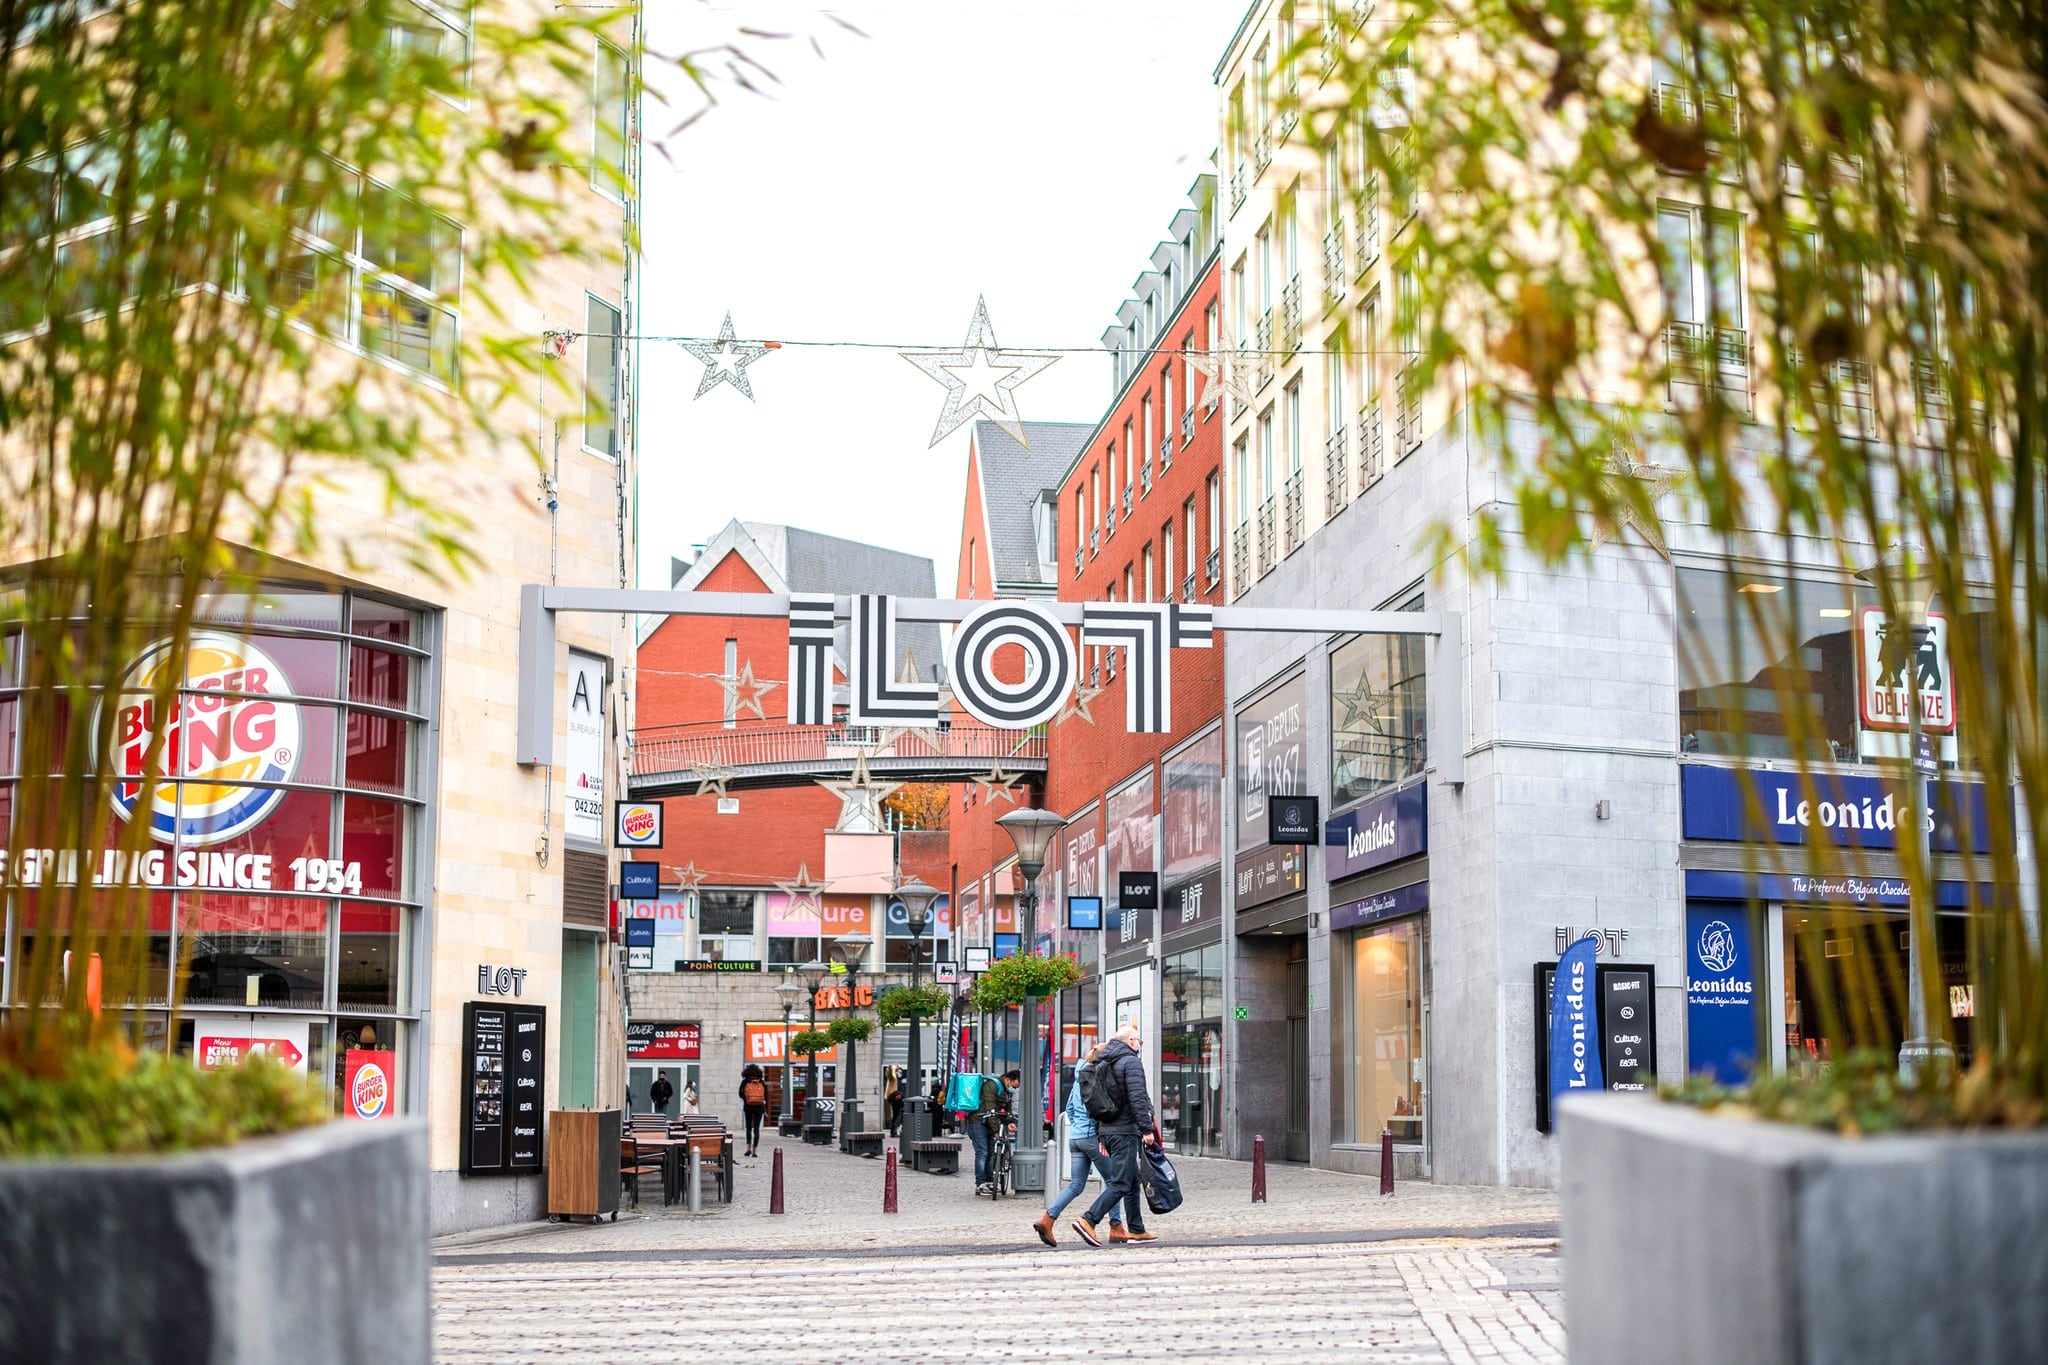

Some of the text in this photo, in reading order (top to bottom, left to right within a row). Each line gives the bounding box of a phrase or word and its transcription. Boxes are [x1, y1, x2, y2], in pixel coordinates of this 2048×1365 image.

[118, 668, 269, 747] BURGER
[1875, 691, 1944, 720] DELHIZE
[1267, 703, 1299, 747] DEPUIS
[125, 701, 276, 799] KING
[1268, 744, 1300, 796] 1867
[575, 799, 588, 813] 042
[626, 813, 653, 825] BURGER
[627, 819, 654, 834] KING
[1347, 812, 1396, 859] Leonidas
[178, 851, 271, 889] SINCE
[288, 857, 362, 896] 1954
[626, 876, 653, 885] Cultura
[1792, 878, 1806, 892] The
[1808, 878, 1846, 896] Preferred
[1848, 879, 1878, 901] Belgian
[690, 962, 755, 970] POINTCULTURE
[1687, 976, 1752, 993] Leonidas
[815, 985, 873, 1010] BASIC
[1567, 961, 1587, 1088] Leonidas
[206, 1056, 239, 1066] DEAL
[357, 1075, 383, 1094] BURGER
[358, 1085, 383, 1107] KING
